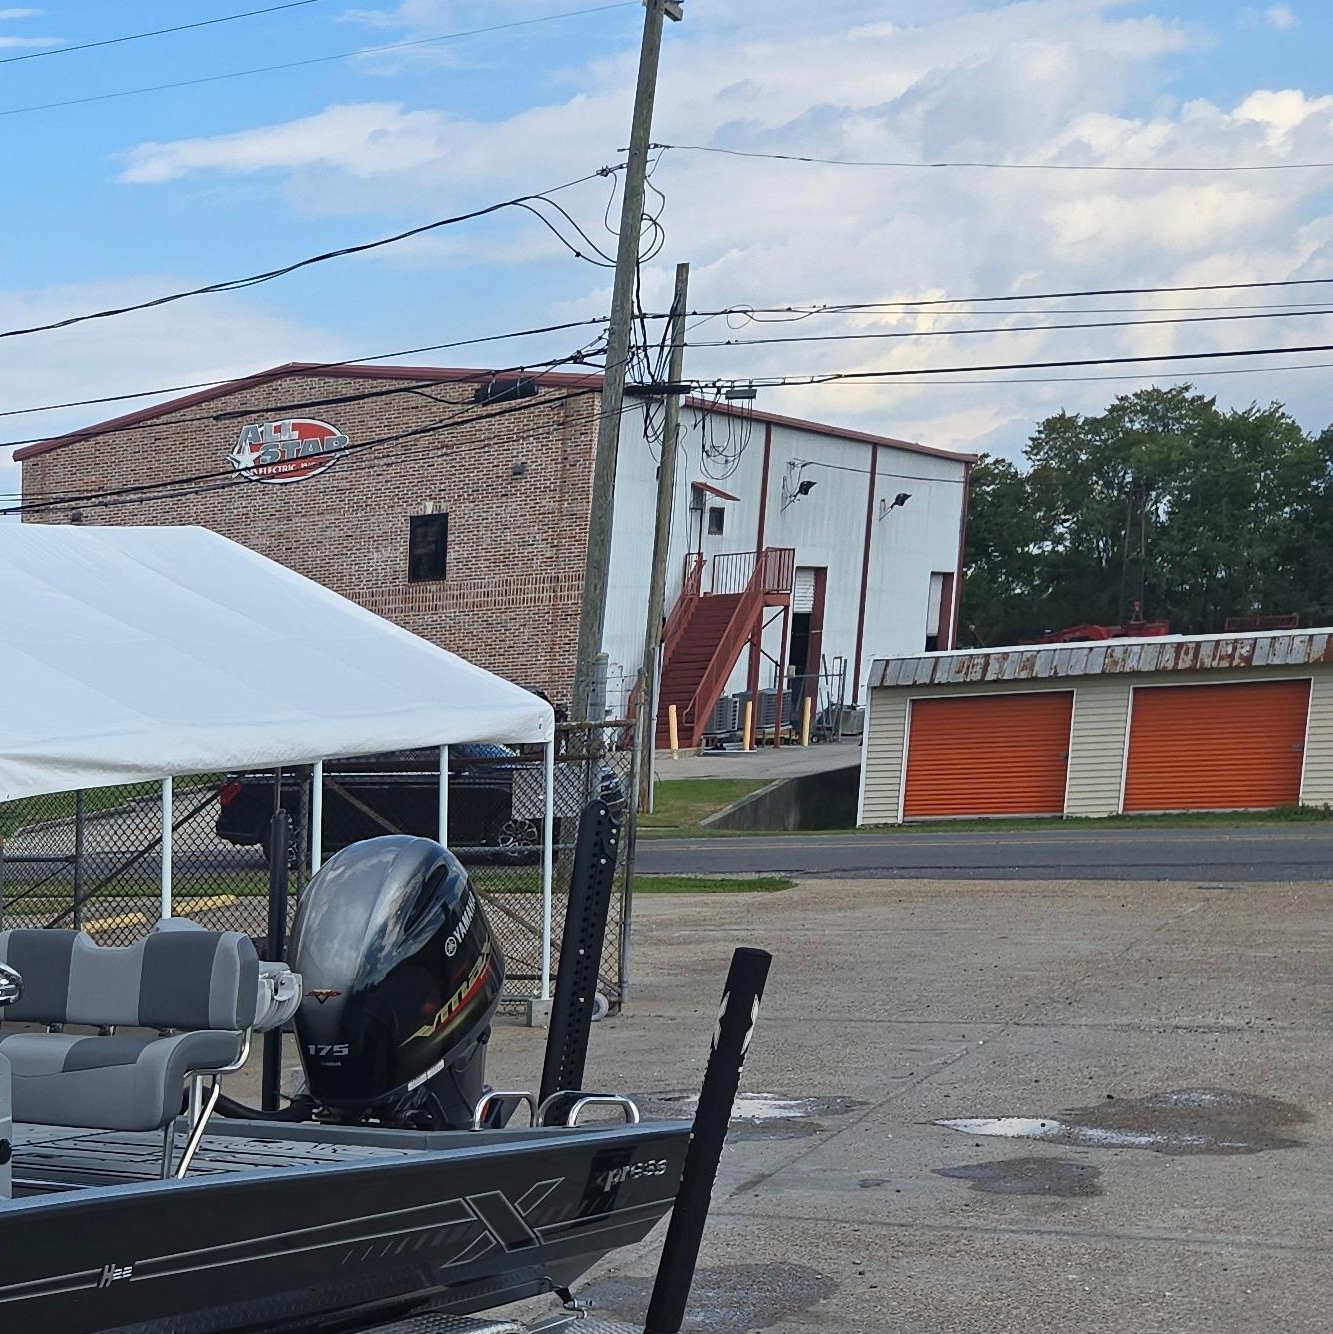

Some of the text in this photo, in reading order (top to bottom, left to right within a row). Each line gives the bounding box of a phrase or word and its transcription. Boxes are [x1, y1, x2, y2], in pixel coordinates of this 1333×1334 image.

[233, 421, 299, 455] ALL
[259, 435, 349, 465] STAR
[307, 1043, 350, 1056] 175
